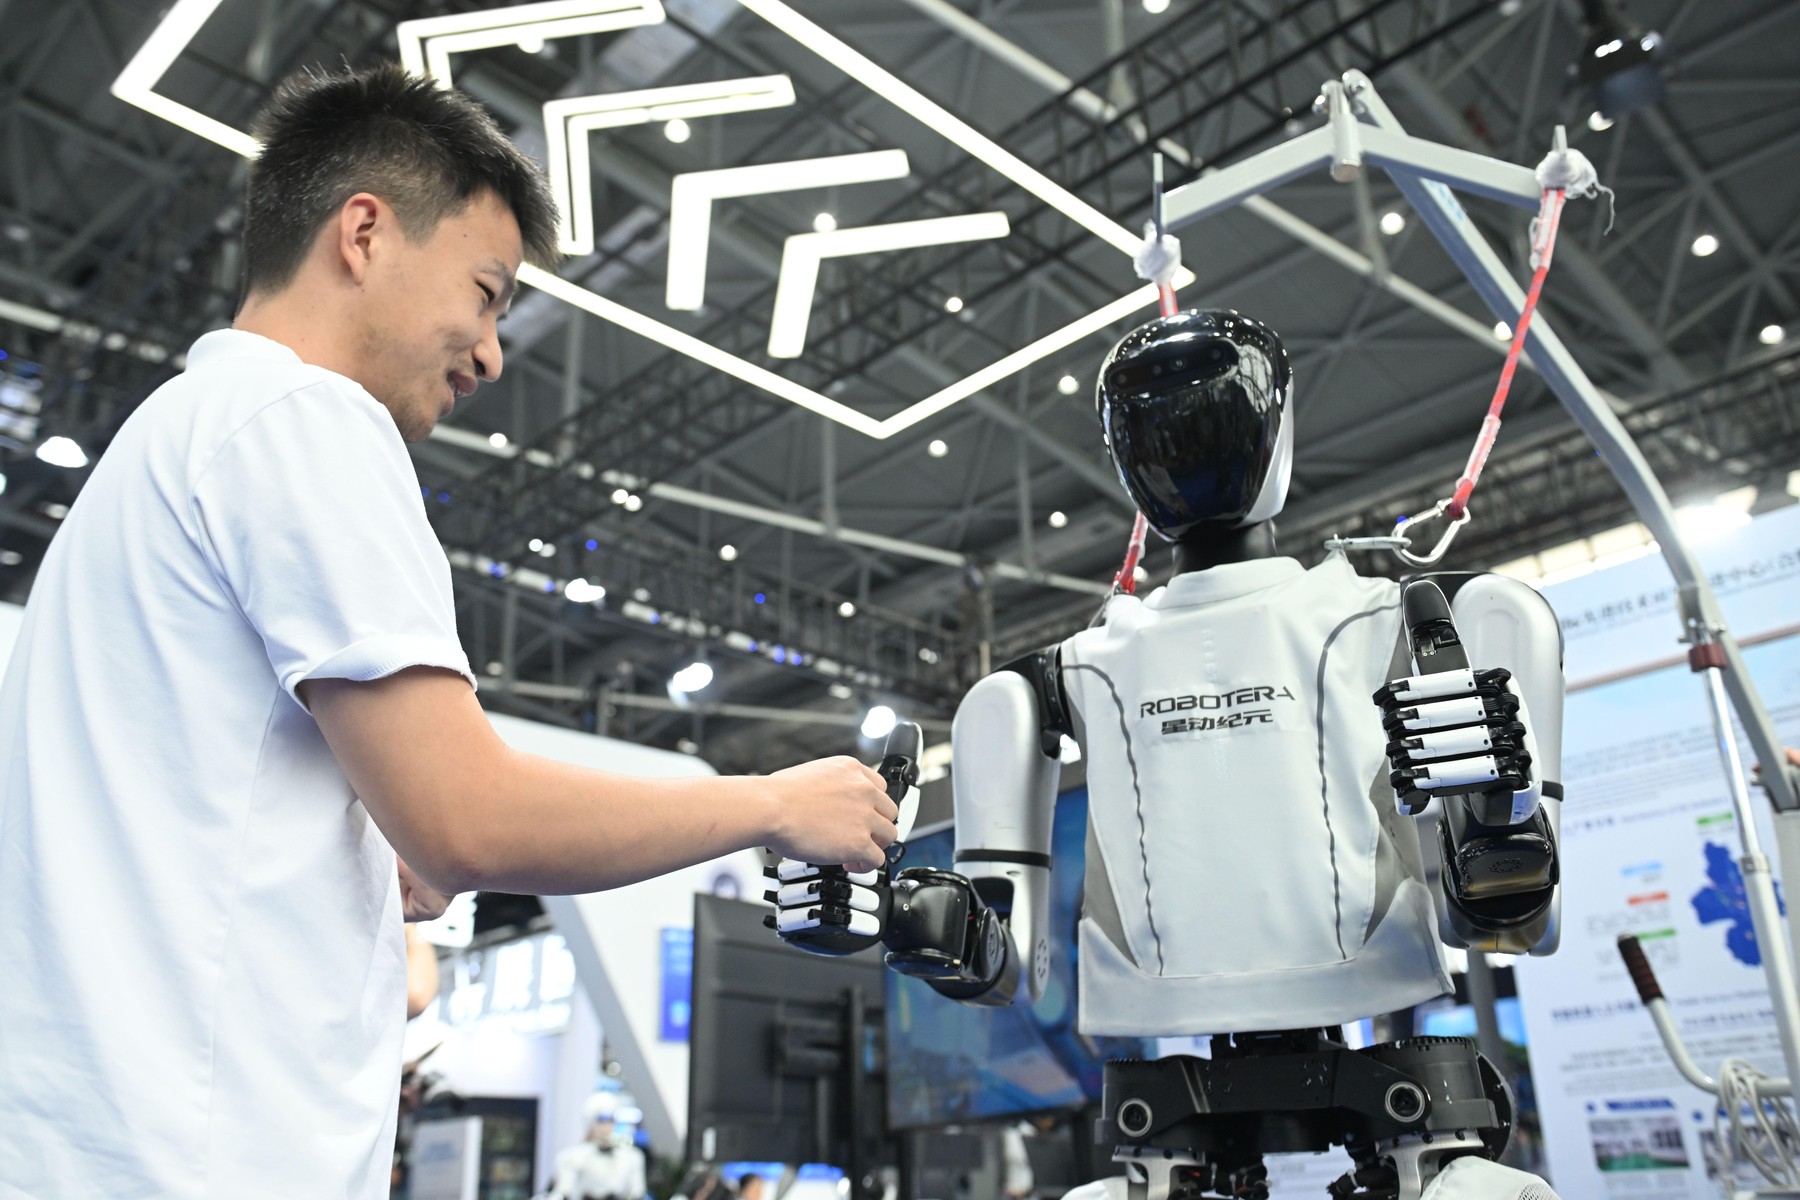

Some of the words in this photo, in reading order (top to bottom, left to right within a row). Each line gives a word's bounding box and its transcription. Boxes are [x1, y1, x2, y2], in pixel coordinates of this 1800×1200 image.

[1140, 686, 1295, 718] ROBOTERA
[1161, 709, 1273, 735] 星动纪元
